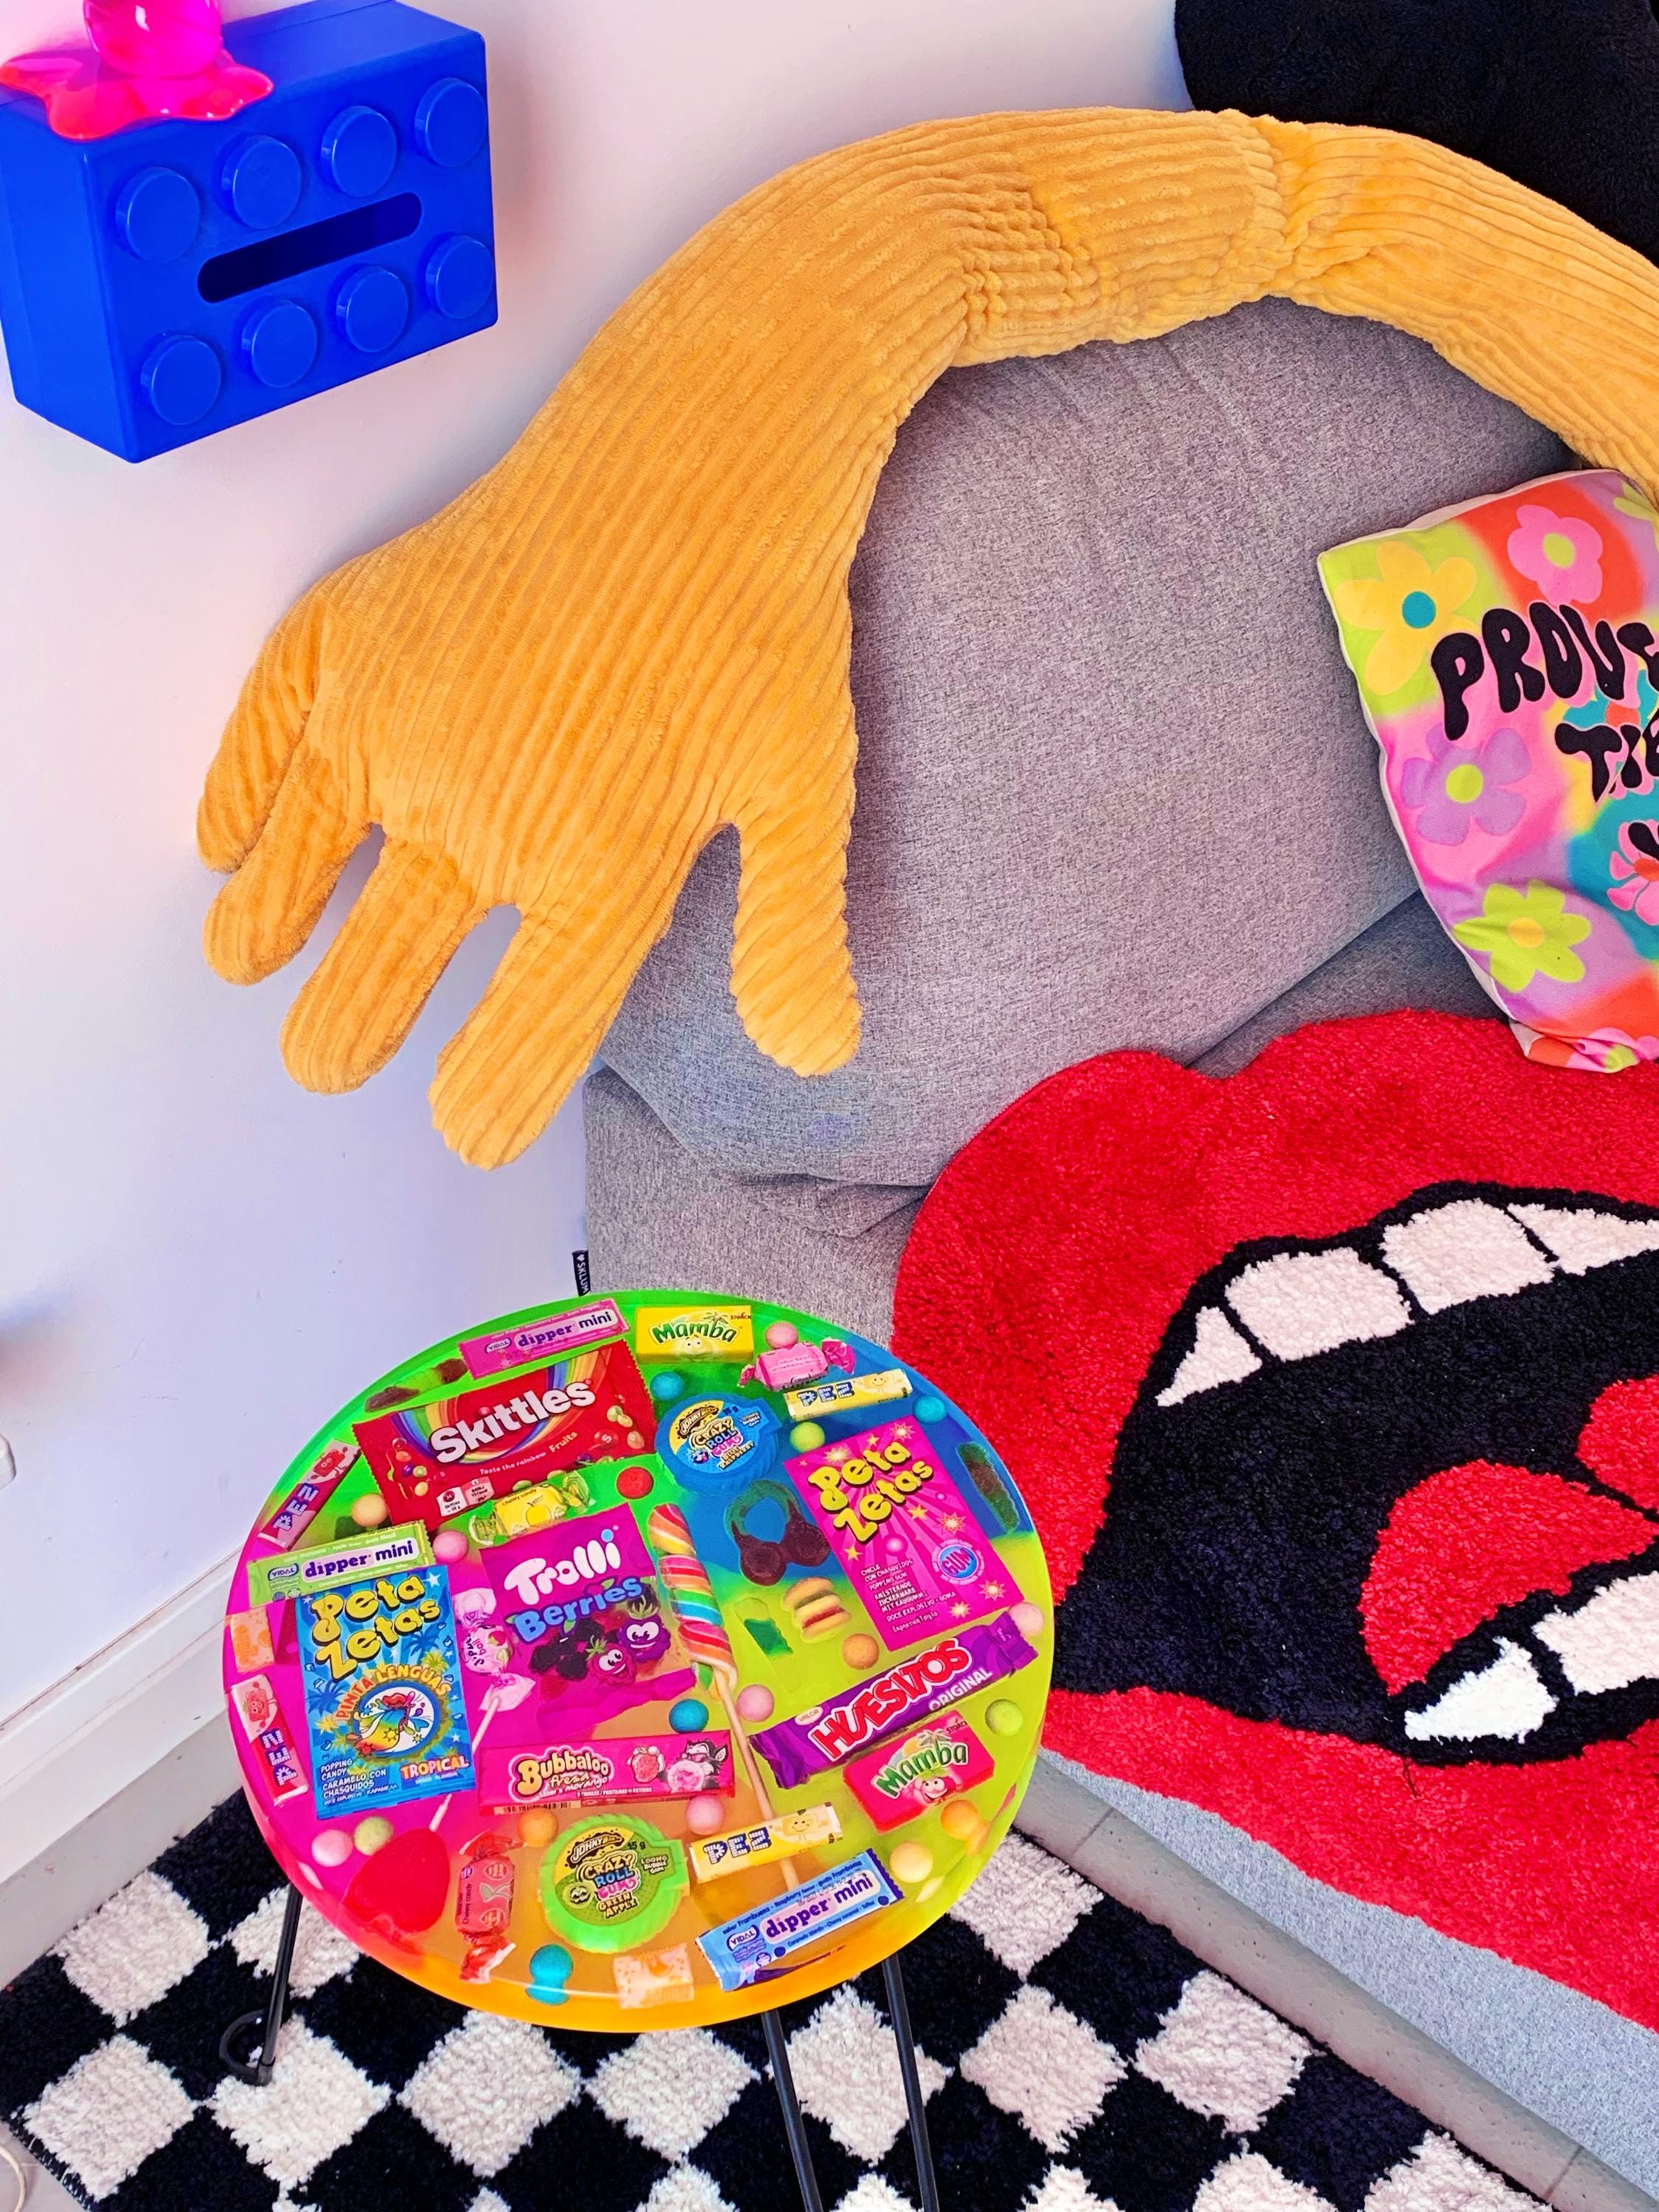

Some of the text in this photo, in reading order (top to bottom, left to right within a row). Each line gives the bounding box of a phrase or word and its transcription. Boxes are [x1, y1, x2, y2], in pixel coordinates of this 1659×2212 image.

[577, 1262, 589, 1293] SKLUM
[518, 1324, 572, 1347] dipper
[579, 1311, 612, 1329] mini
[651, 1322, 737, 1344] Mamba
[487, 1340, 509, 1352] VIDAL
[796, 1381, 855, 1407] PEZ
[431, 1382, 595, 1463] Skittles
[681, 1411, 702, 1434] JOHNY
[695, 1418, 732, 1444] CRAZY
[549, 1431, 578, 1453] Fruits
[706, 1429, 737, 1449] ROLL
[480, 1451, 546, 1475] Taste the rainbow
[808, 1441, 912, 1513] Peta
[271, 1483, 319, 1531] PEZ
[832, 1460, 934, 1543] Zetas
[305, 1554, 368, 1578] dipper
[375, 1540, 414, 1562] mini
[504, 1528, 622, 1605] Trolli
[861, 1564, 880, 1576] CHICLE
[865, 1558, 914, 1582] CON CHASQUIDOS
[942, 1548, 973, 1574] GUM
[271, 1568, 294, 1577] VIDAL
[869, 1571, 908, 1590] POPPING GUM
[874, 1581, 912, 1600] KNISTERNDE
[882, 1590, 928, 1613] MIT KAUGUMMI
[310, 1576, 425, 1646] Peta
[515, 1577, 643, 1642] Berries
[887, 1591, 956, 1622] DOCE EXPLOSIVO GOMA
[315, 1600, 441, 1683] Zetas
[472, 1638, 487, 1656] ball
[335, 1665, 453, 1720] PINTA LENGUAS
[810, 1639, 970, 1759] HUESITOS
[928, 1666, 992, 1711] ORIGINAL
[259, 1728, 298, 1786] PEZ
[321, 1758, 353, 1773] POPPING
[400, 1756, 470, 1779] TROPICAL
[875, 1740, 967, 1797] Mamba
[321, 1767, 347, 1781] CANDY
[323, 1769, 386, 1791] CARAMELO CON
[517, 1750, 609, 1796] Bubbaloo
[550, 1773, 590, 1788] fresa
[565, 1776, 608, 1792] morango
[323, 1780, 375, 1799] CHASQUIDOS
[574, 1838, 603, 1860] JOHNY
[627, 1841, 646, 1850] 15 g
[703, 1827, 772, 1865] PEZ
[584, 1854, 633, 1881] CRAZY
[594, 1867, 634, 1888] ROLL
[598, 1878, 639, 1899] GUM
[599, 1893, 631, 1910] GREEN
[605, 1899, 637, 1918] APPLE
[737, 1907, 771, 1926] Frambuesa
[773, 1892, 802, 1907] Raspberry
[765, 1898, 829, 1938] dipper
[833, 1873, 874, 1905] mini
[730, 1927, 755, 1946] VIDAL
